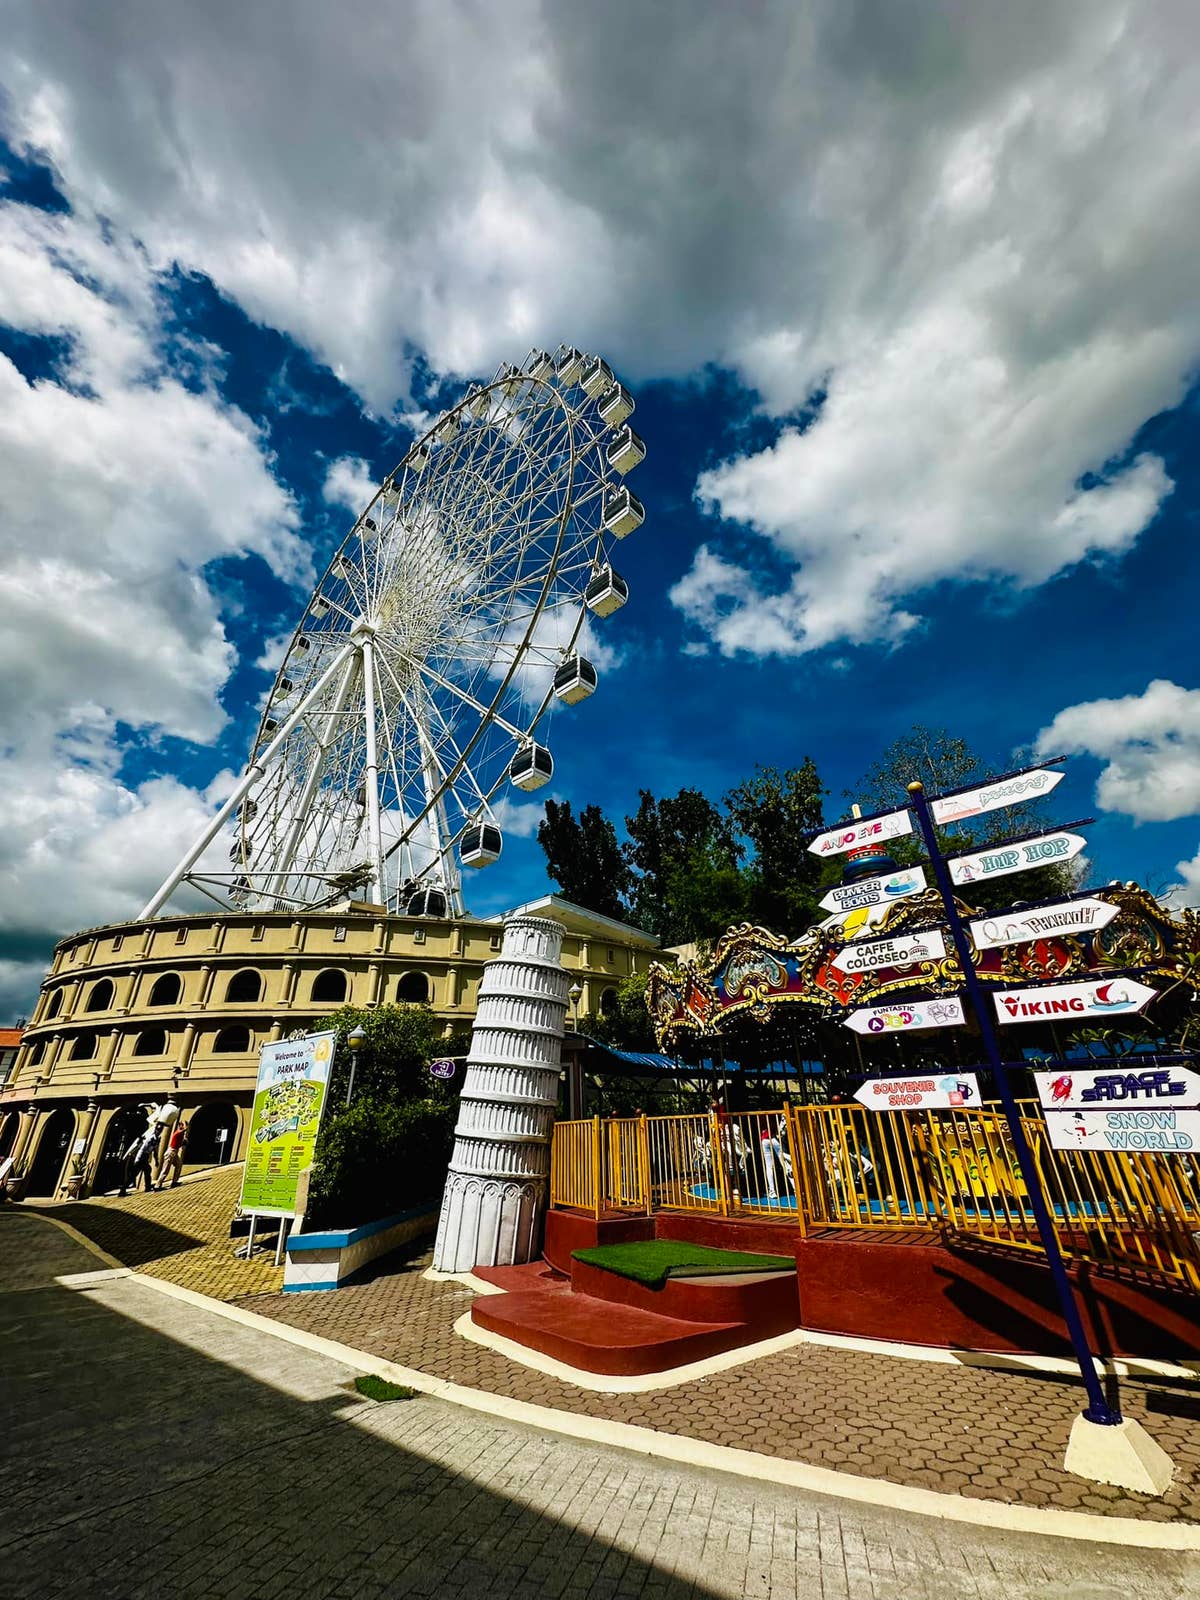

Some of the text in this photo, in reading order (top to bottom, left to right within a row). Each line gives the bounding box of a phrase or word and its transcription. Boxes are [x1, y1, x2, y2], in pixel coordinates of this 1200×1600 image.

[821, 823, 882, 852] ANJO EYE
[979, 837, 1070, 873] HIP HOP
[833, 880, 881, 901] BUMPER
[842, 892, 880, 909] BOATS
[857, 941, 894, 957] CAFFE
[846, 950, 908, 970] COLOSSEO
[873, 1005, 915, 1016] FUNTASTIC
[1005, 997, 1085, 1017] VIKING
[868, 1012, 923, 1032] ARENA
[275, 1052, 297, 1061] Welcome
[277, 1061, 309, 1074] PARK MAP
[872, 1080, 936, 1095] SOUVENIR
[1093, 1070, 1171, 1087] SPACE
[888, 1094, 922, 1106] SHOP
[1081, 1081, 1188, 1102] SHUTTLE
[1106, 1112, 1176, 1130] SNOW
[1104, 1131, 1193, 1149] WORLD
